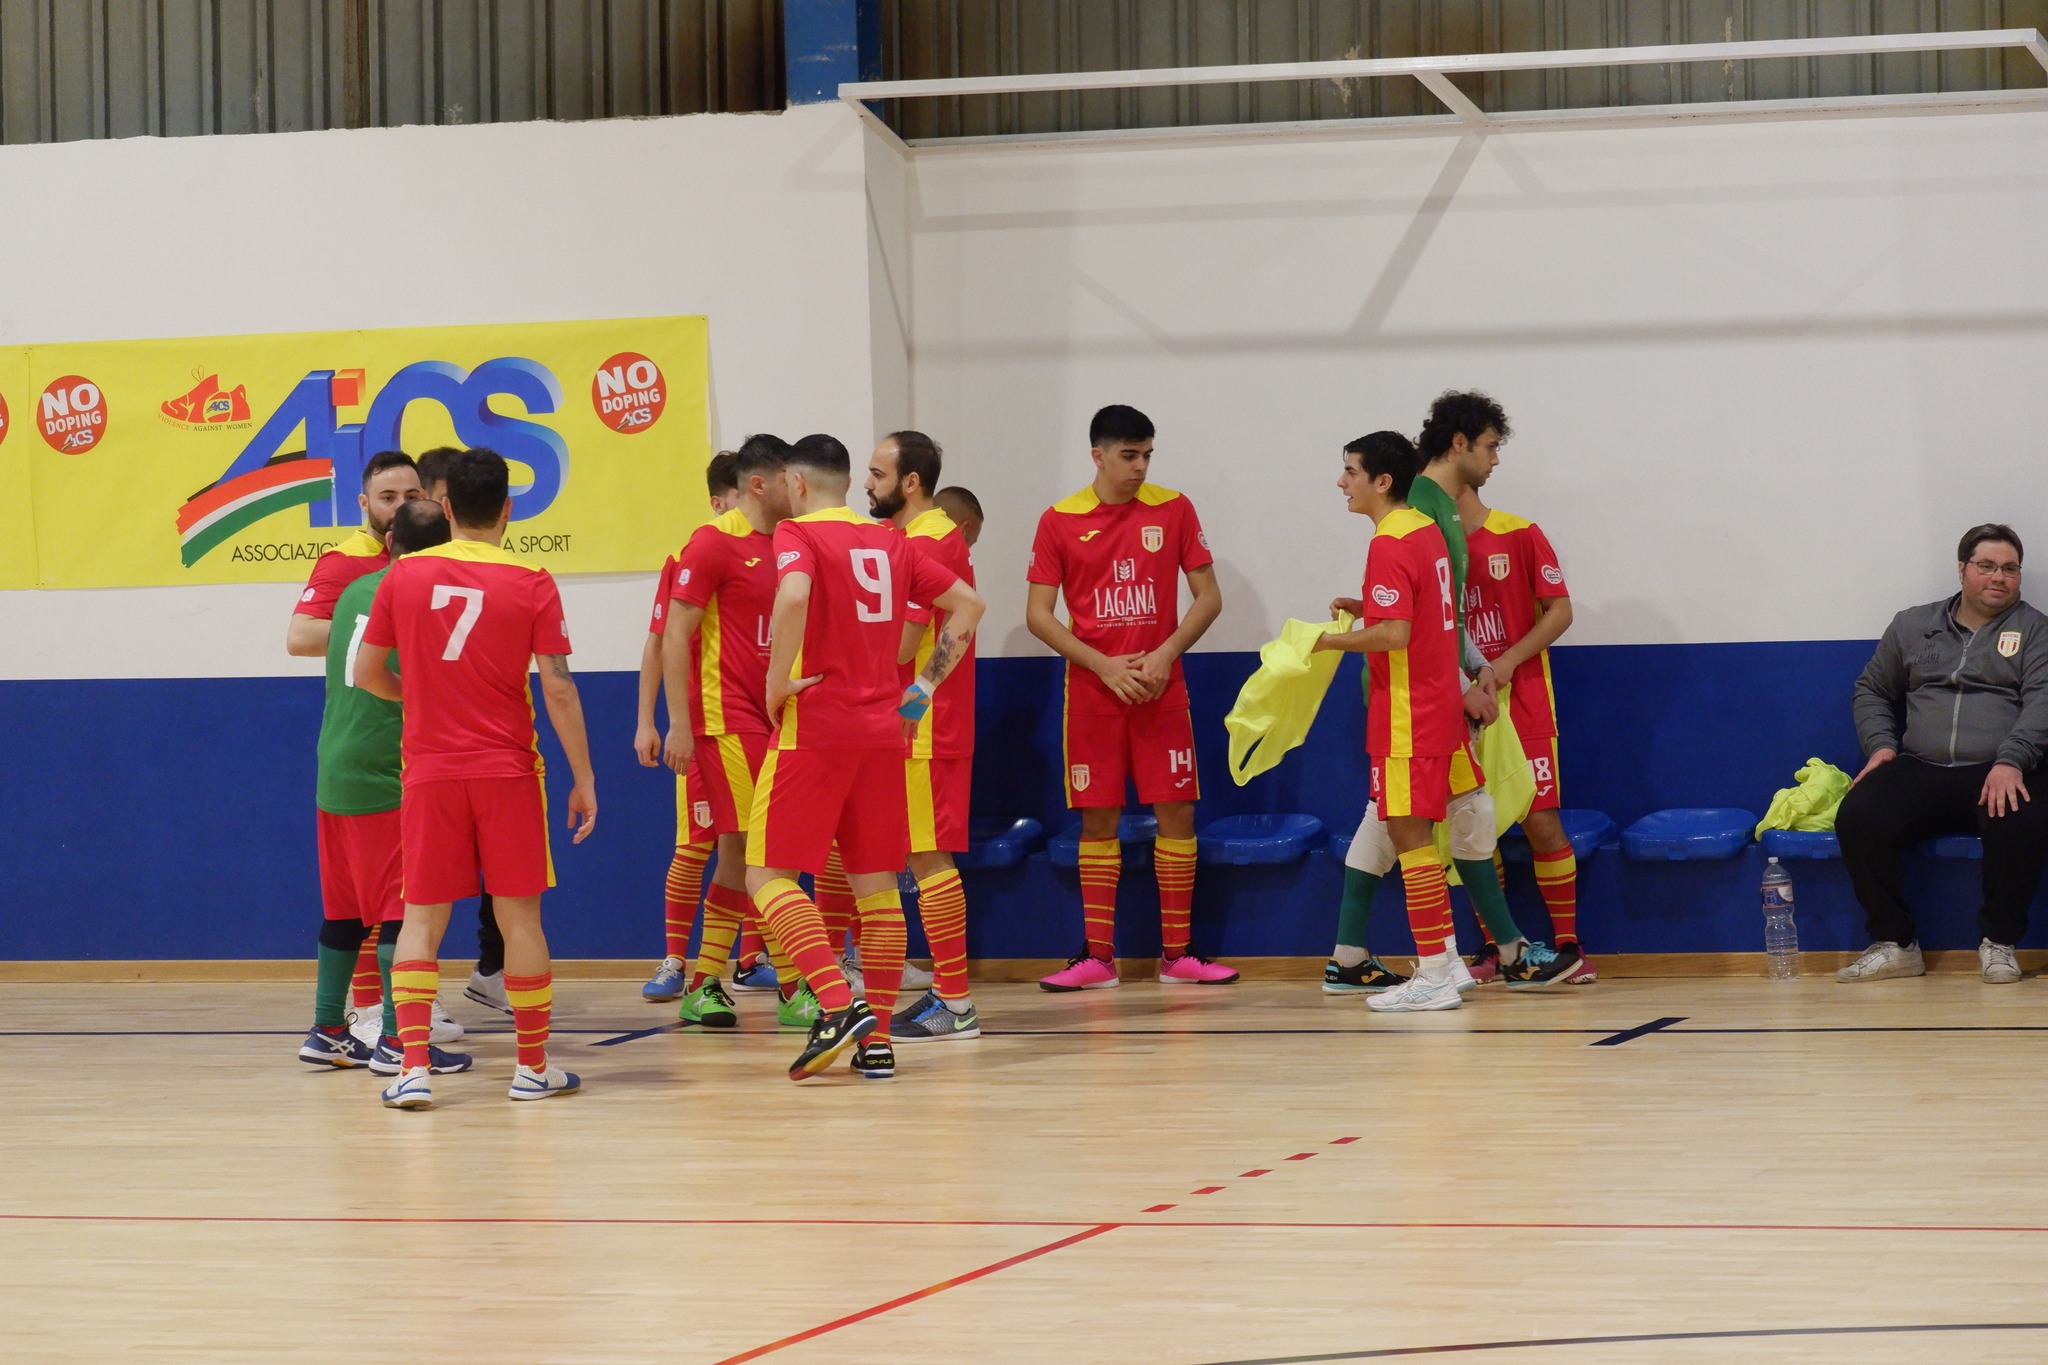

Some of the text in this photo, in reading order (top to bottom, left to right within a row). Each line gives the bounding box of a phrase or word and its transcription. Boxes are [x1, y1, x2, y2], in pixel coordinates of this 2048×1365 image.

[597, 358, 657, 397] NO
[41, 383, 100, 419] NO
[602, 388, 661, 414] DOPING
[45, 410, 102, 436] DOPING
[157, 413, 253, 432] VIOLENCE AGAINST WOMEN
[520, 535, 571, 553] SPORT
[849, 547, 893, 623] 9
[1094, 577, 1157, 618] LAGANÀ
[1435, 557, 1454, 632] 8
[430, 584, 485, 661] 7
[1168, 748, 1192, 773] 14
[1371, 767, 1380, 792] 8
